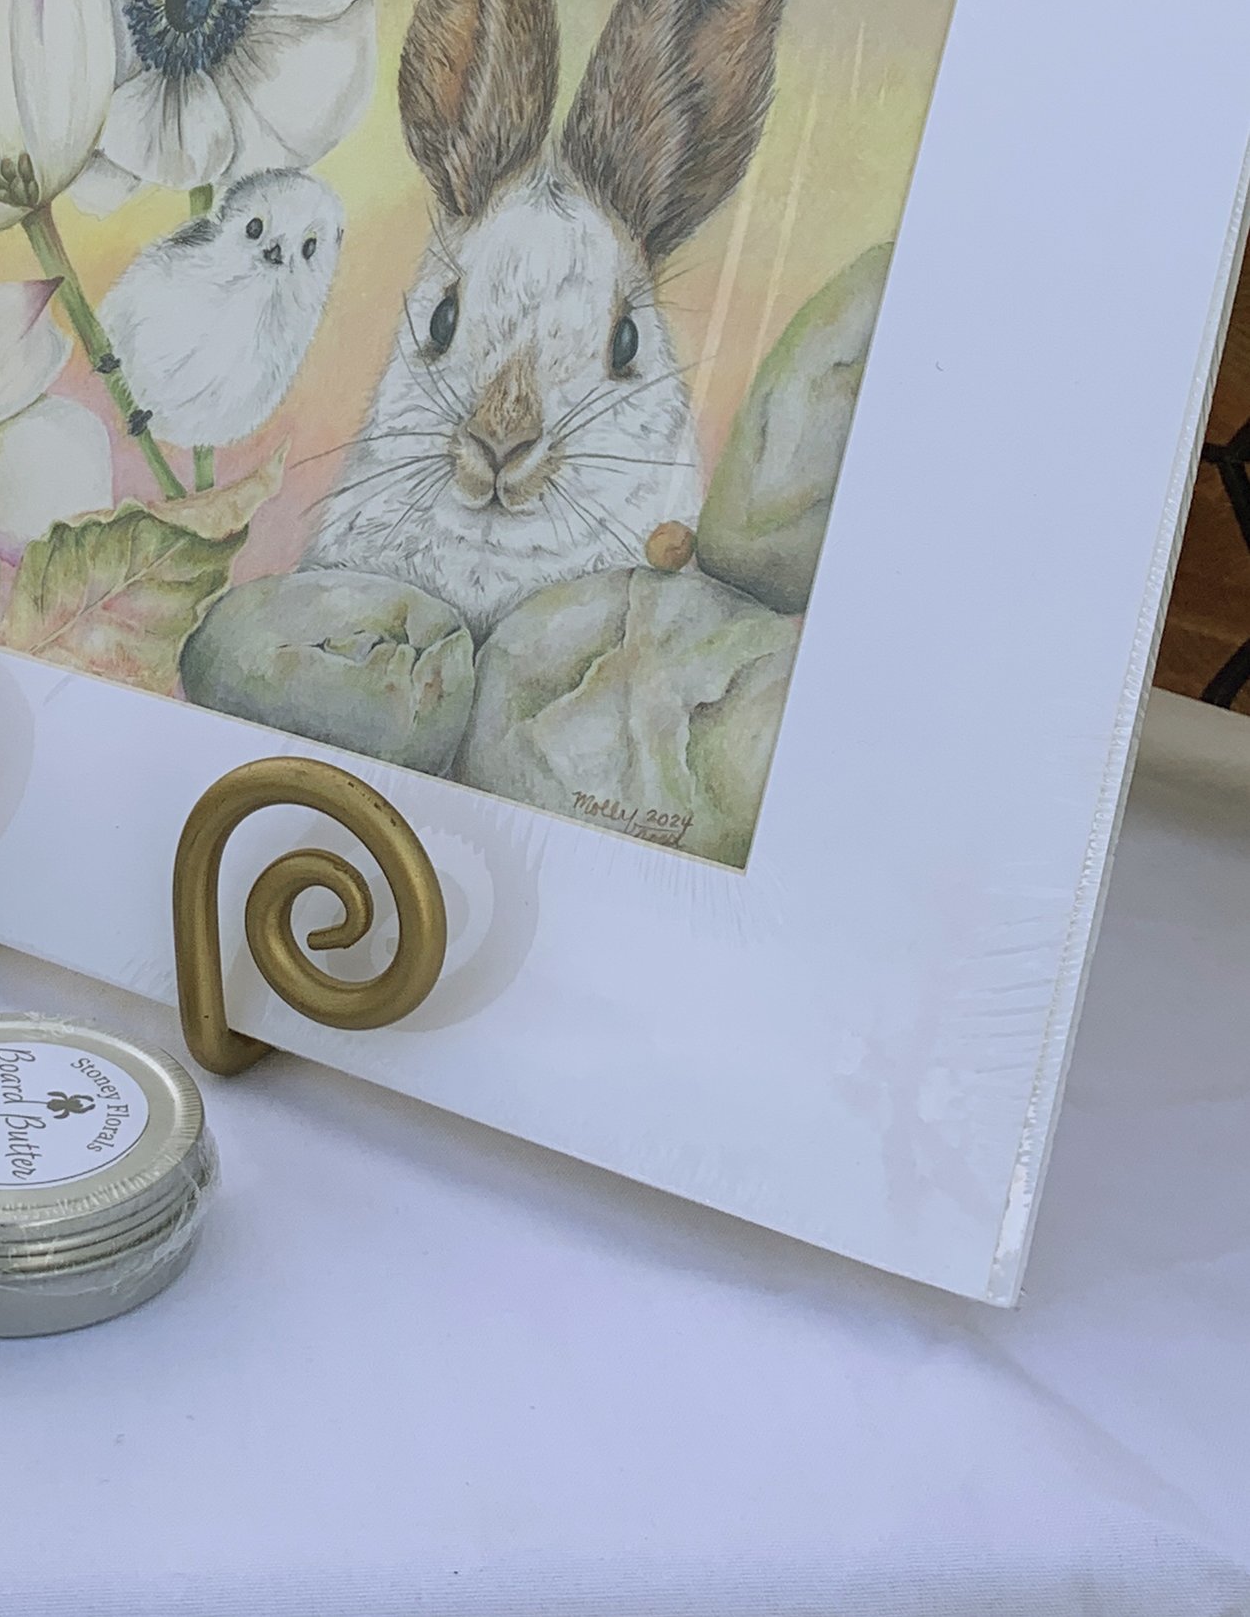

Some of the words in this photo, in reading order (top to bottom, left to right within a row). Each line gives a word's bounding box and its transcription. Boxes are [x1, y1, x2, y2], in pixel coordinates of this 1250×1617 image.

[571, 790, 639, 835] Molly
[646, 808, 695, 839] 2024
[70, 1057, 122, 1102] Stoney
[86, 1104, 131, 1154] Florals
